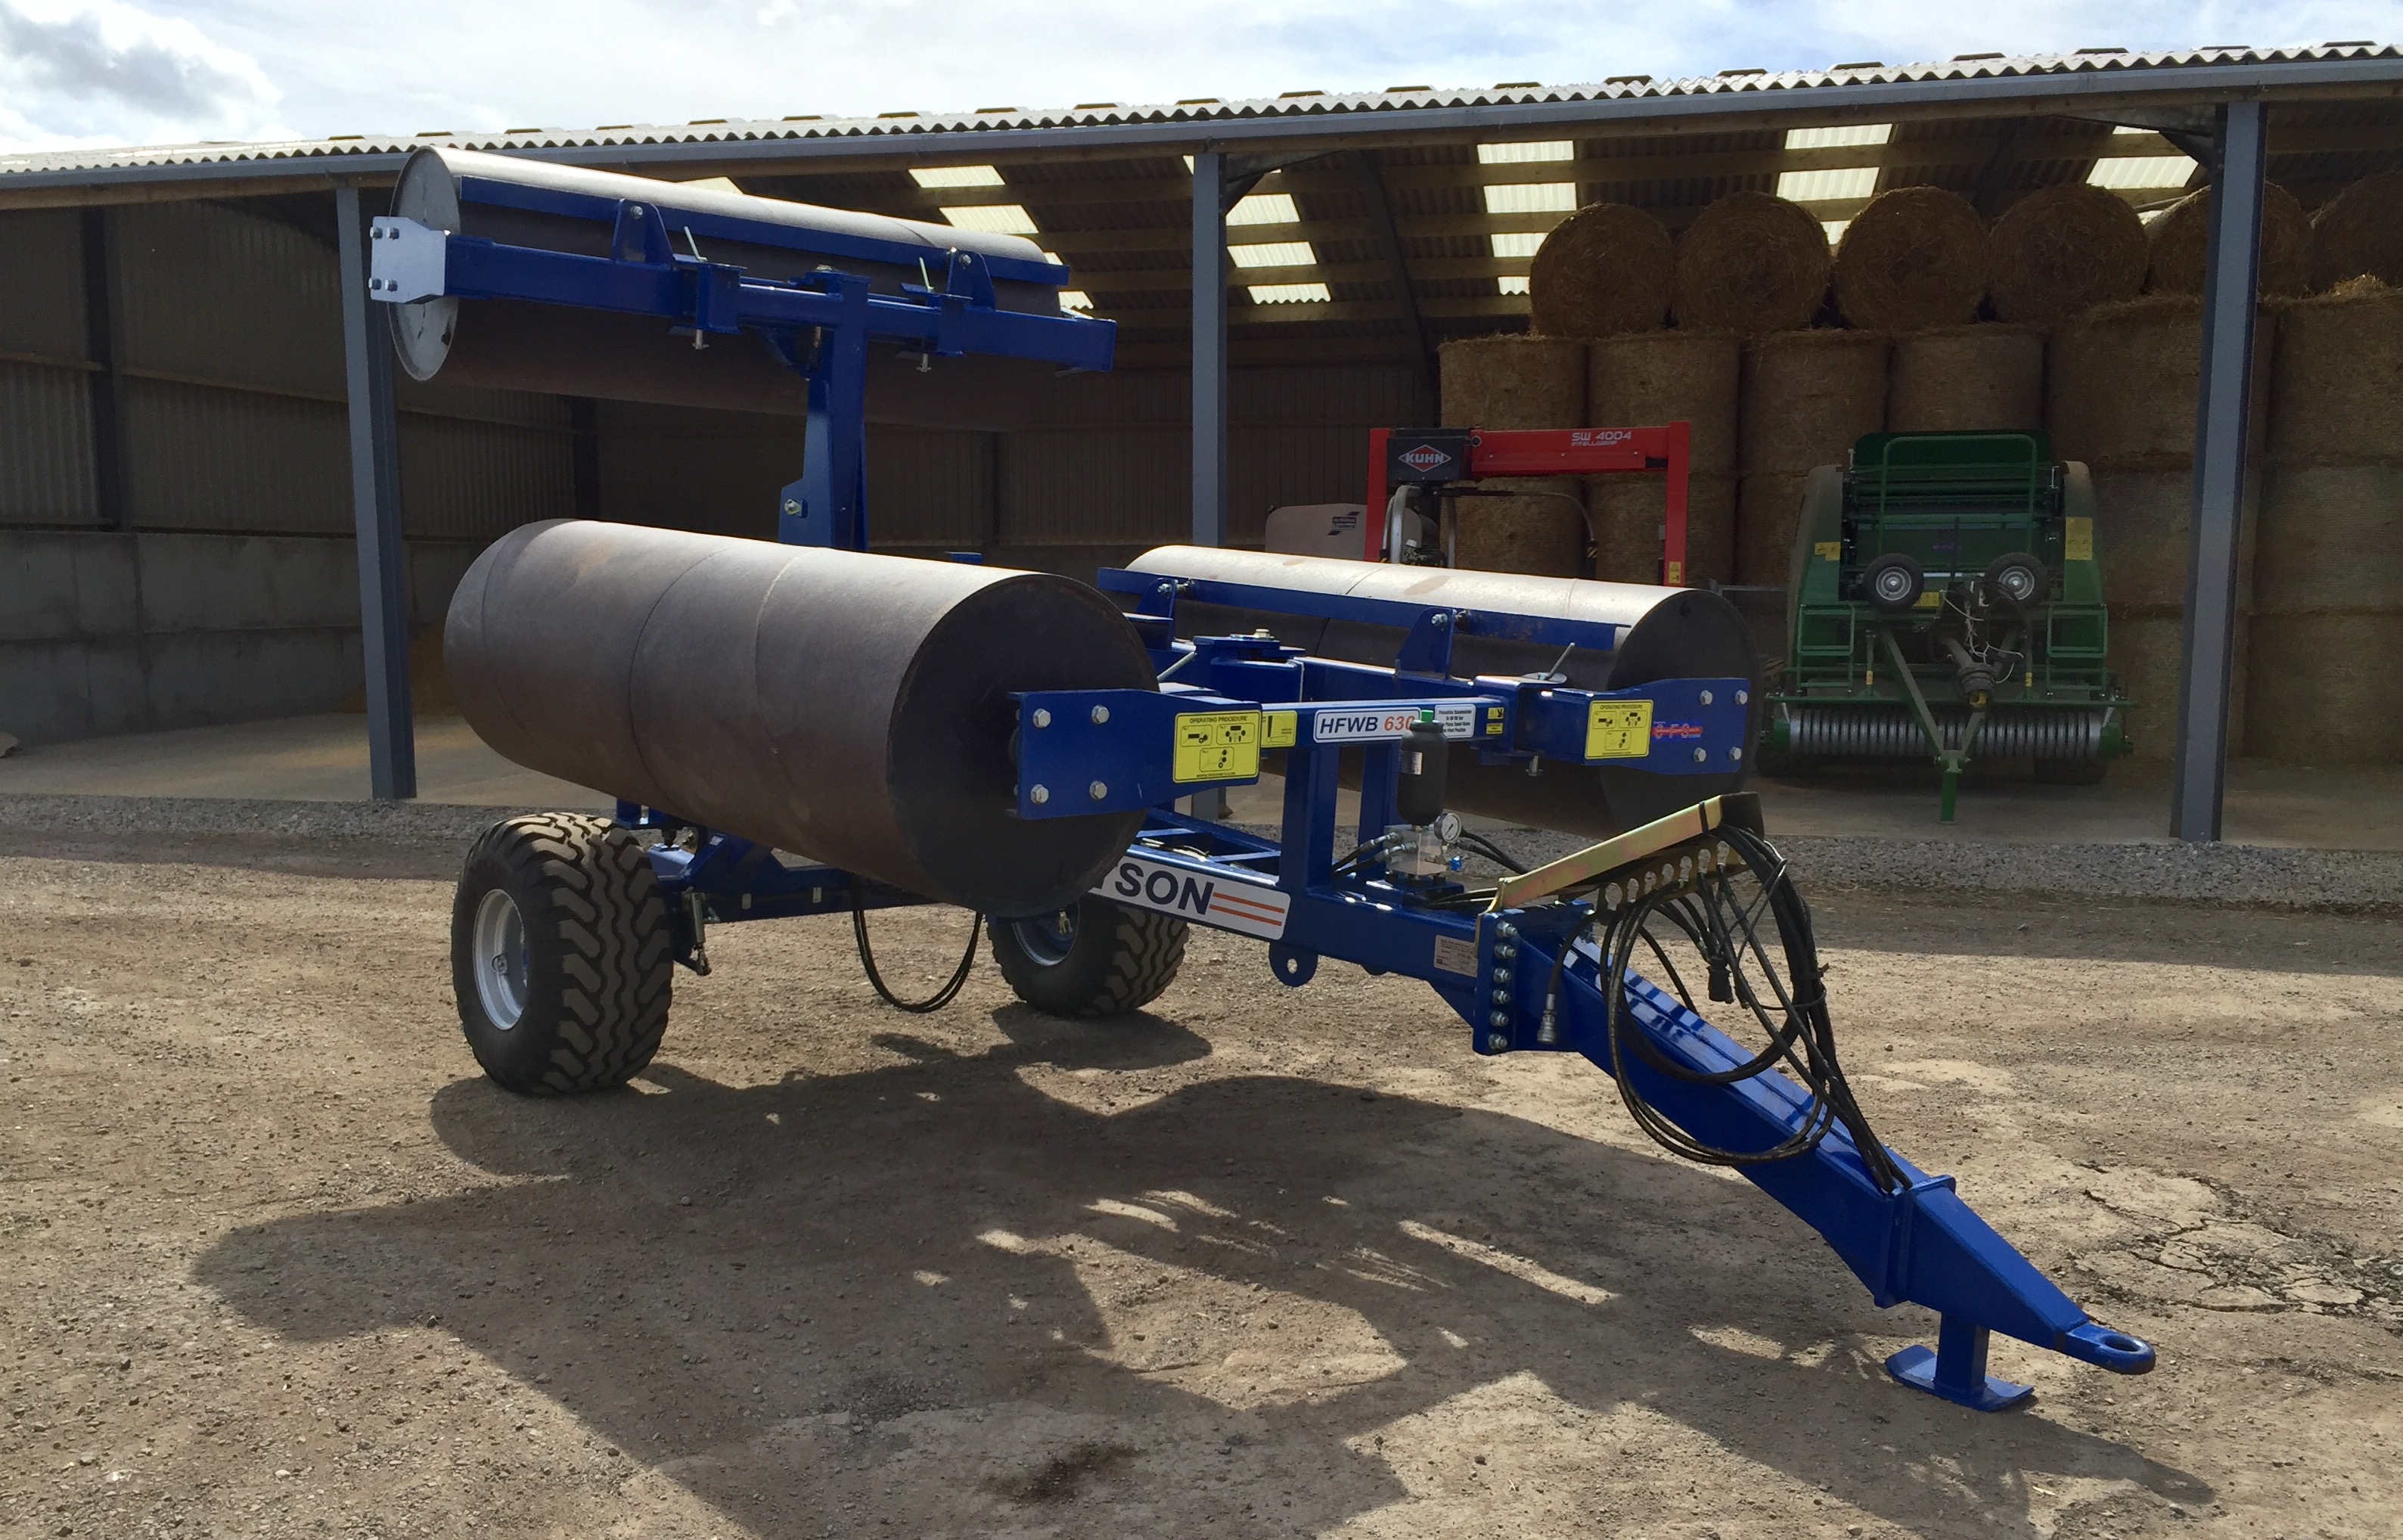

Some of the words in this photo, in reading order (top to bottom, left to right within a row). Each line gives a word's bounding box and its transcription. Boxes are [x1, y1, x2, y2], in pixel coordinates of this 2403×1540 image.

[1572, 432, 1591, 441] SW
[1596, 430, 1631, 440] 4004
[1405, 453, 1444, 463] KUHN
[1320, 716, 1378, 734] HFWB
[1383, 715, 1416, 732] 630
[1104, 862, 1214, 915] SON
